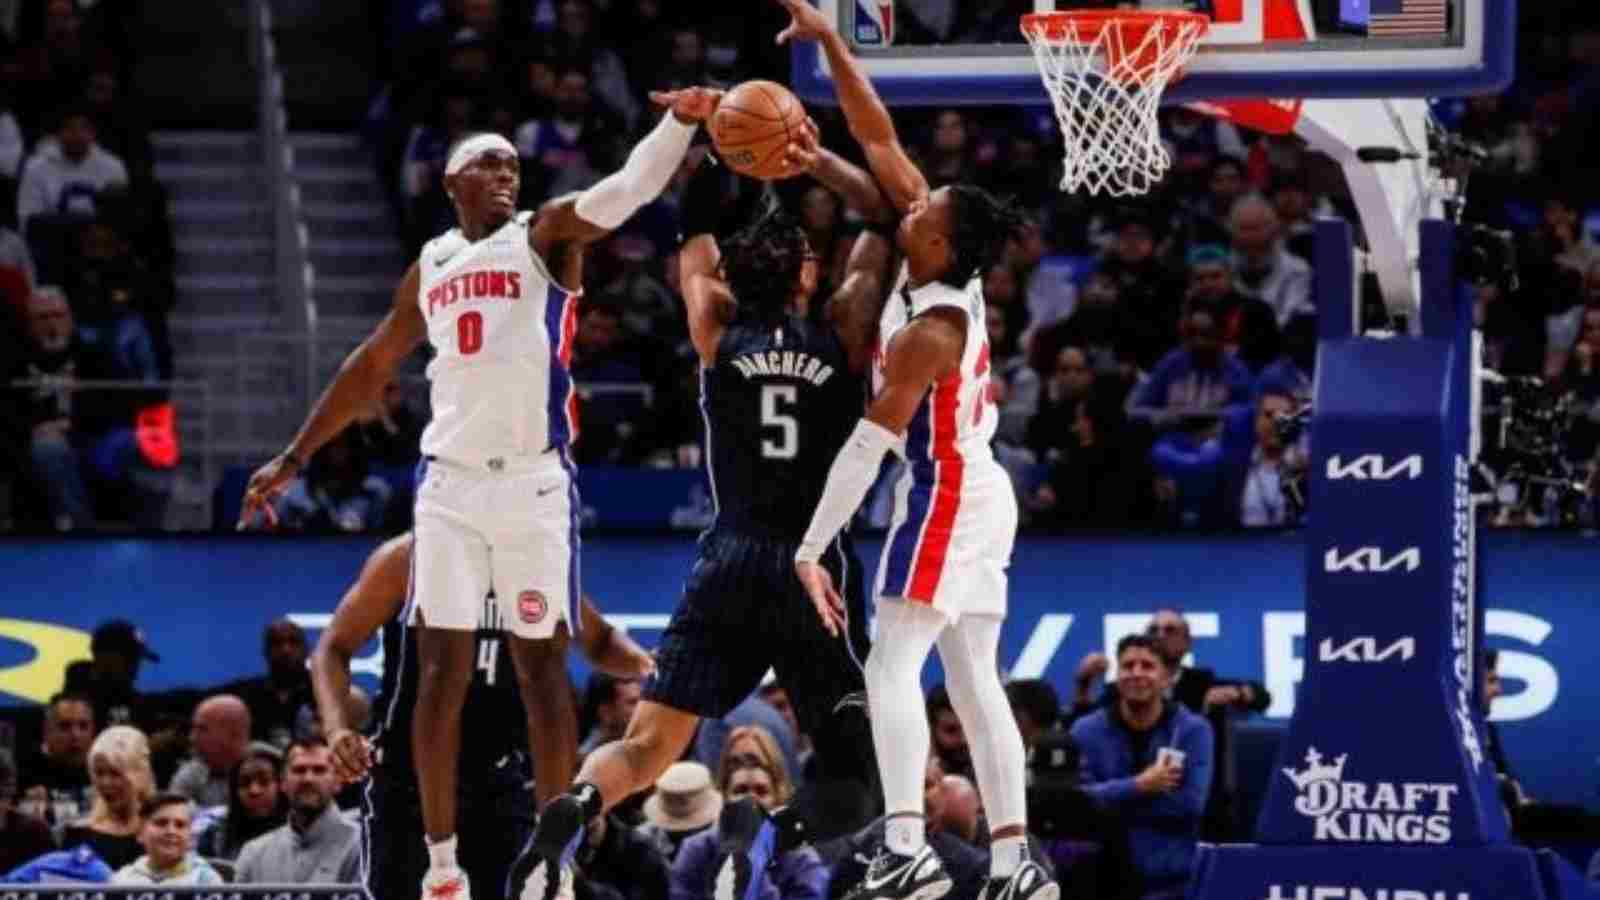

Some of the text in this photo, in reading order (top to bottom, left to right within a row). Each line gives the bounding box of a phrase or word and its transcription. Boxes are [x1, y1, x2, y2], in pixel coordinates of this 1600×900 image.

[427, 270, 521, 317] PISTONS
[457, 310, 483, 355] 0
[761, 384, 799, 460] 5
[1326, 454, 1422, 480] KIA
[1324, 546, 1420, 572] KIA
[477, 639, 499, 685] 4
[1319, 637, 1415, 662] KIA
[1294, 779, 1459, 817] DRAFT
[1314, 809, 1451, 844] KINGS
